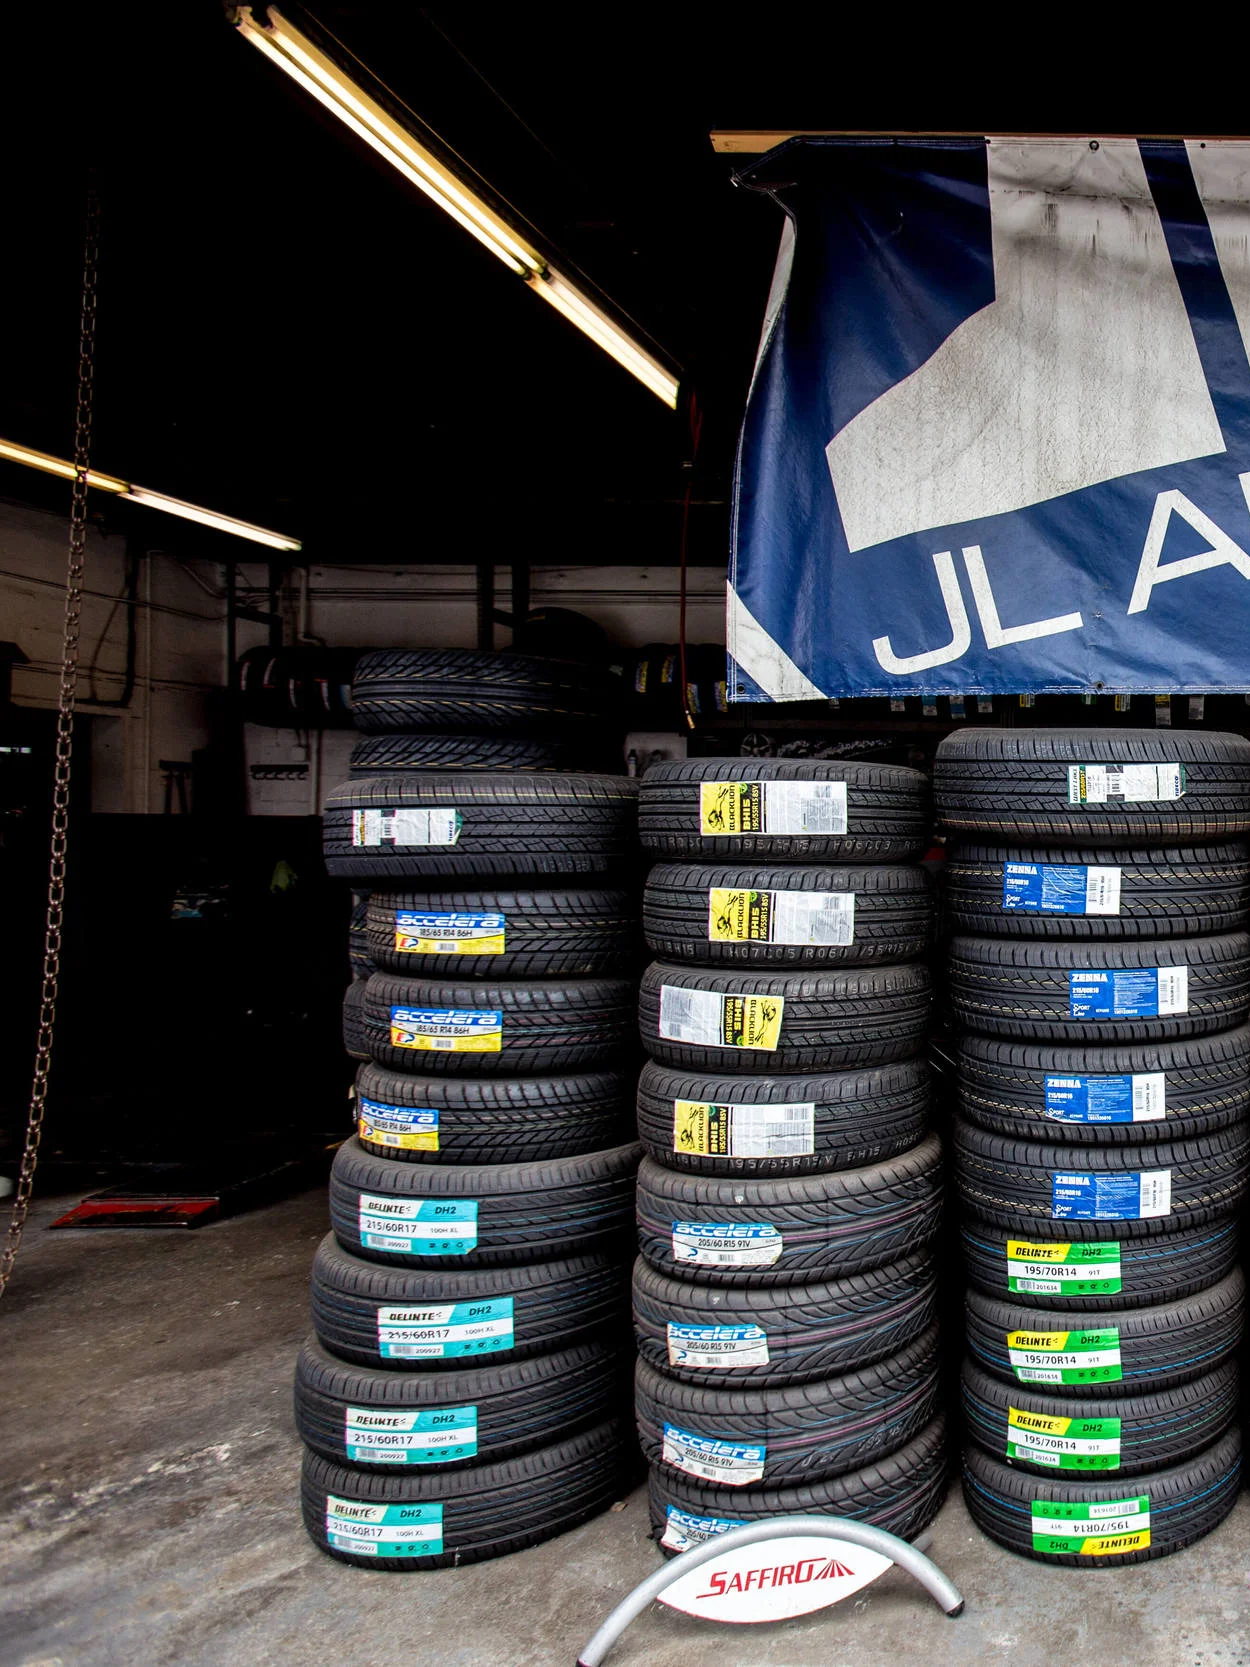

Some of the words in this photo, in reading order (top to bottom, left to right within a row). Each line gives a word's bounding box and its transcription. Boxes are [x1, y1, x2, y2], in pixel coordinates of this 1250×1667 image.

[872, 544, 1085, 675] JL
[751, 797, 759, 831] 195/55R15
[1006, 864, 1038, 875] ZENNA
[399, 912, 500, 928] accelera
[759, 905, 768, 940] 195/55R15
[419, 928, 442, 937] 185/65
[456, 929, 473, 938] 86H
[1071, 973, 1108, 982] ZENNA
[394, 1010, 498, 1025] accelera
[748, 999, 757, 1045] BLACKLION
[454, 1027, 470, 1035] 86H
[1047, 1078, 1082, 1088] ZENNA
[361, 1102, 435, 1124] accelera
[719, 1121, 727, 1153] 195/55R15
[1055, 1175, 1090, 1186] ZENNA
[368, 1202, 405, 1215] DELINTE
[435, 1206, 457, 1215] DH2
[366, 1219, 417, 1234] 215/60R17
[675, 1222, 778, 1238] accelera
[698, 1238, 721, 1248] 205/60
[723, 1239, 736, 1248] R15
[737, 1239, 751, 1248] 91V
[1015, 1247, 1053, 1258] DELINTE
[1024, 1265, 1077, 1276] 195/70R14
[389, 1312, 435, 1321] DELINTE
[469, 1306, 492, 1316] DH2
[388, 1329, 450, 1340] 215/60R17
[686, 1341, 709, 1351] 205/60
[710, 1342, 722, 1351] R15
[723, 1342, 736, 1350] 91V
[1015, 1336, 1051, 1347] DELINTE
[1080, 1335, 1100, 1345] DH2
[1025, 1354, 1077, 1365] 195/70R14
[356, 1415, 400, 1426] DELINTE
[432, 1414, 456, 1424] DH2
[1016, 1415, 1054, 1430] DELINTE
[1082, 1423, 1103, 1432] DH2
[354, 1433, 413, 1445] 215/60R17
[667, 1428, 761, 1459] accelera
[1024, 1434, 1077, 1451] 195/70R14
[685, 1447, 707, 1461] 205/60
[708, 1453, 721, 1464] R15
[721, 1455, 735, 1467] 91V
[334, 1504, 371, 1518] DELINTE
[400, 1509, 422, 1518] DH2
[1073, 1521, 1129, 1532] 195/70R14
[1049, 1541, 1069, 1550] DH2
[1098, 1537, 1140, 1549] DELINTE
[696, 1557, 828, 1599] SAFFIRO
